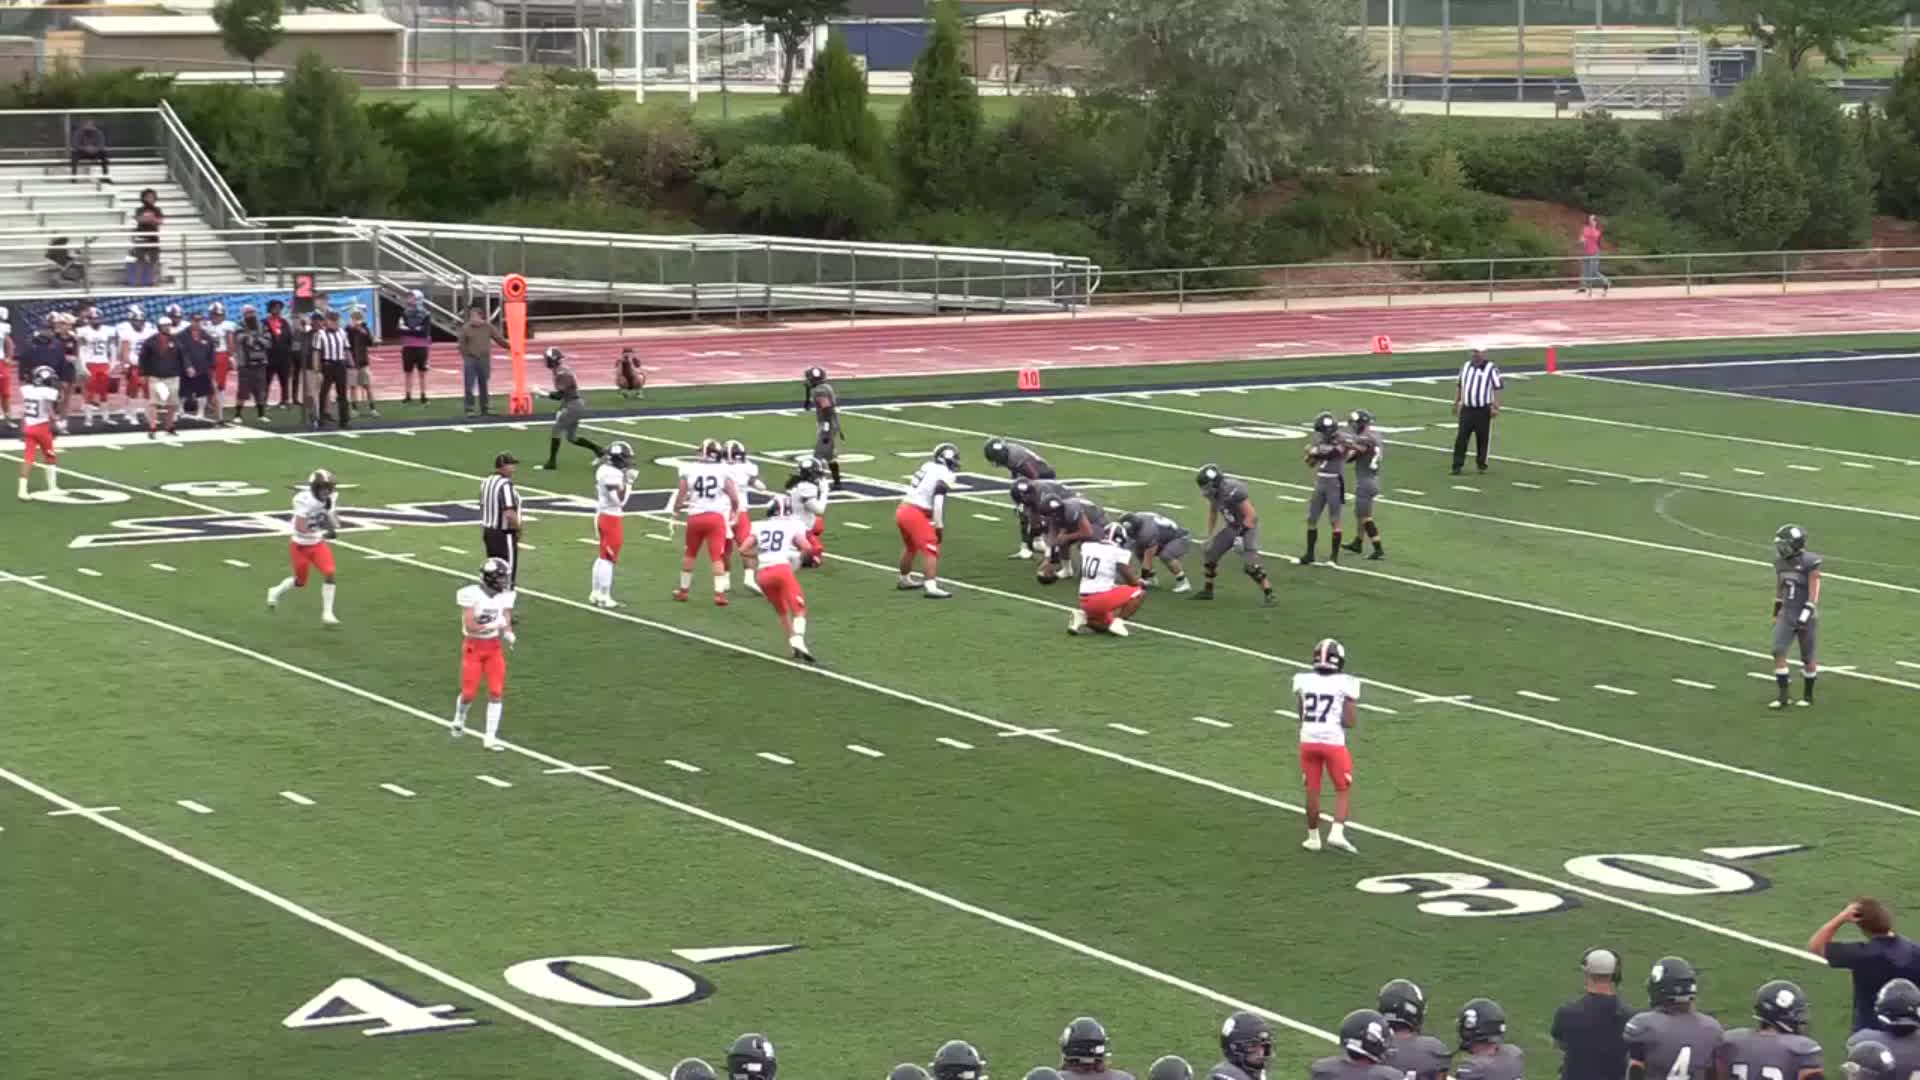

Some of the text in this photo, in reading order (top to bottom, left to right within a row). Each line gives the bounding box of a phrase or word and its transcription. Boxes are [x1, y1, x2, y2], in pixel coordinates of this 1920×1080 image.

[296, 275, 313, 298] 2
[1377, 337, 1389, 351] G
[1023, 371, 1038, 387] 10
[693, 475, 718, 499] 42
[759, 530, 785, 552] 28
[1081, 557, 1101, 580] 10
[1303, 693, 1335, 723] 27
[1666, 1046, 1693, 1080] 4
